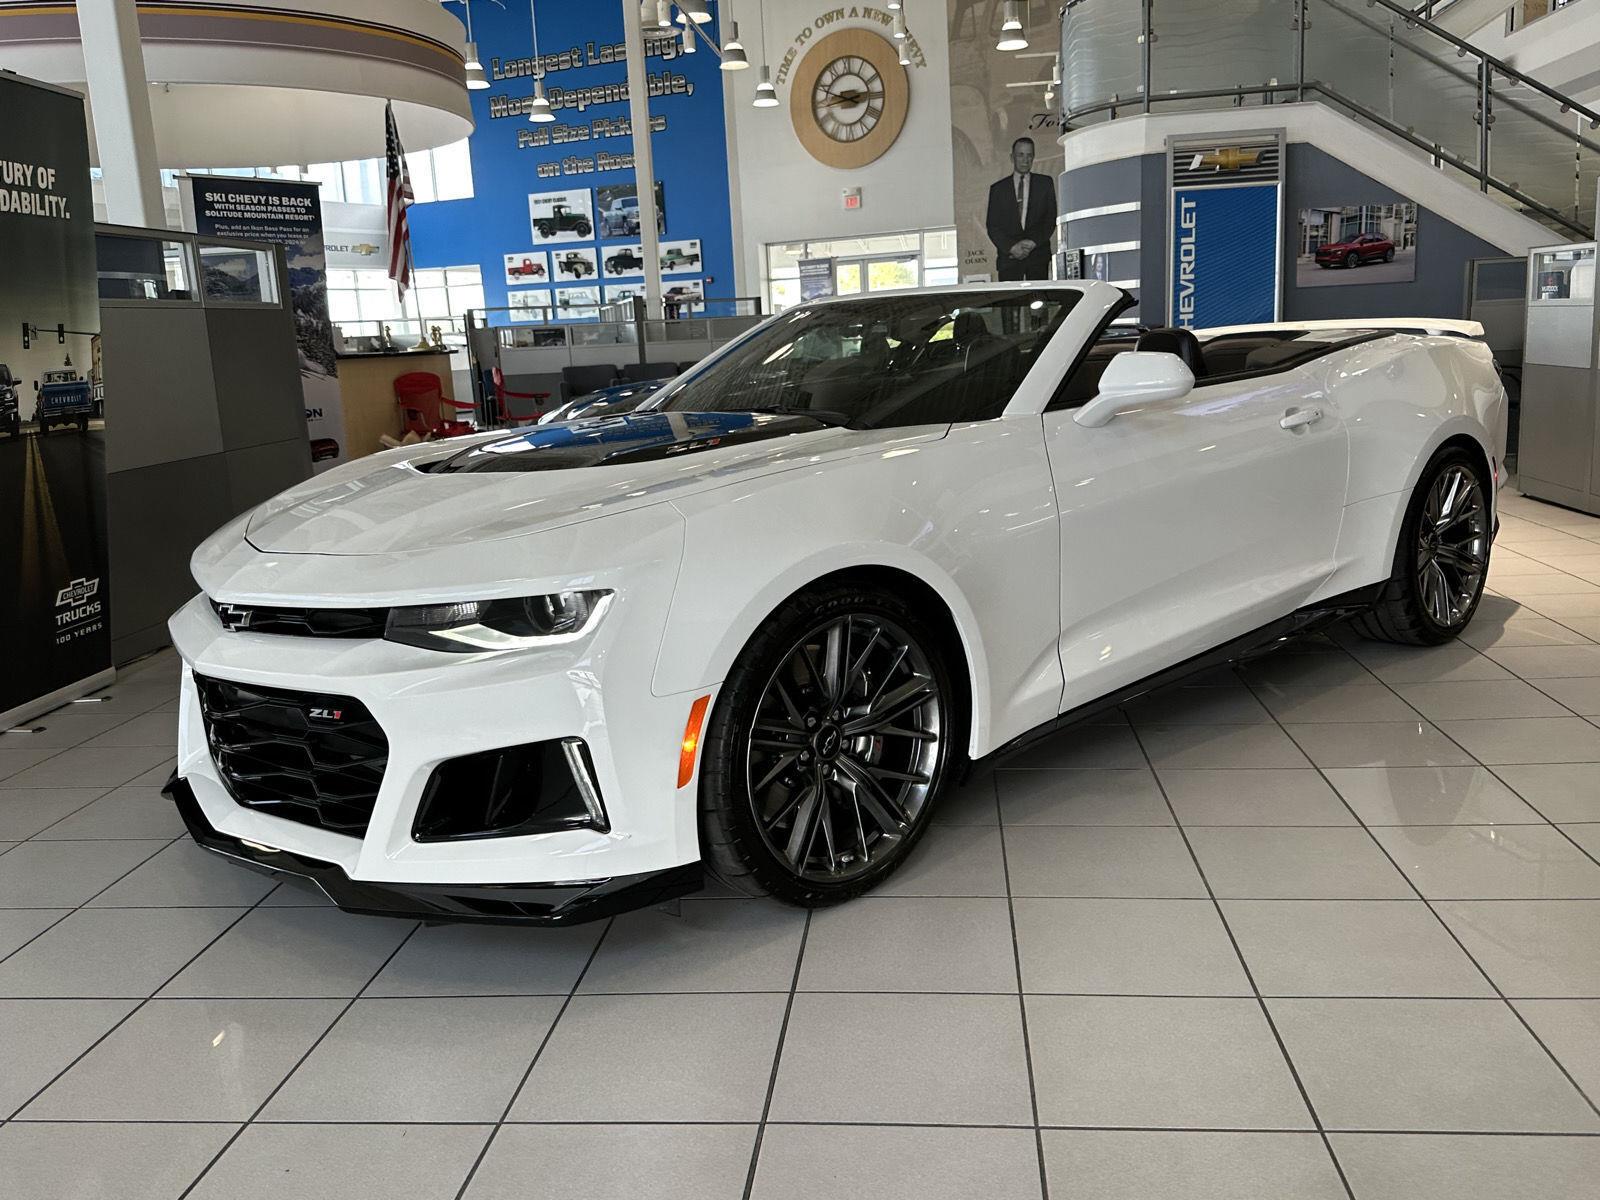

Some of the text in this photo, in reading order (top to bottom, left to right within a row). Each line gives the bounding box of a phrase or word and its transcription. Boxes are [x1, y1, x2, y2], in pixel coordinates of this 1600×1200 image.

[776, 47, 798, 85] TIME
[795, 27, 812, 46] TO
[815, 8, 845, 29] OWN
[848, 7, 859, 18] A
[862, 7, 894, 26] NEW
[491, 37, 685, 80] Longest Lasng,
[489, 71, 694, 118] Mos Depenble,
[517, 114, 667, 149] Full Size Picks
[537, 151, 636, 178] on the Roa
[37, 166, 55, 190] OF
[0, 188, 70, 219] DABILITY.
[205, 192, 312, 207] SKI CHEVY IS BACK
[235, 204, 266, 212] SEASON
[205, 210, 242, 218] SOLITUDE
[243, 212, 284, 220] MOUNTAIN
[324, 244, 349, 252] ROLET
[965, 257, 988, 265] OLSEN
[1179, 197, 1196, 330] HEVROLET
[62, 584, 94, 600] CHEVROLET
[55, 601, 101, 626] TRUCKS
[56, 622, 103, 645] 100 YEARS
[309, 708, 342, 720] ZL1
